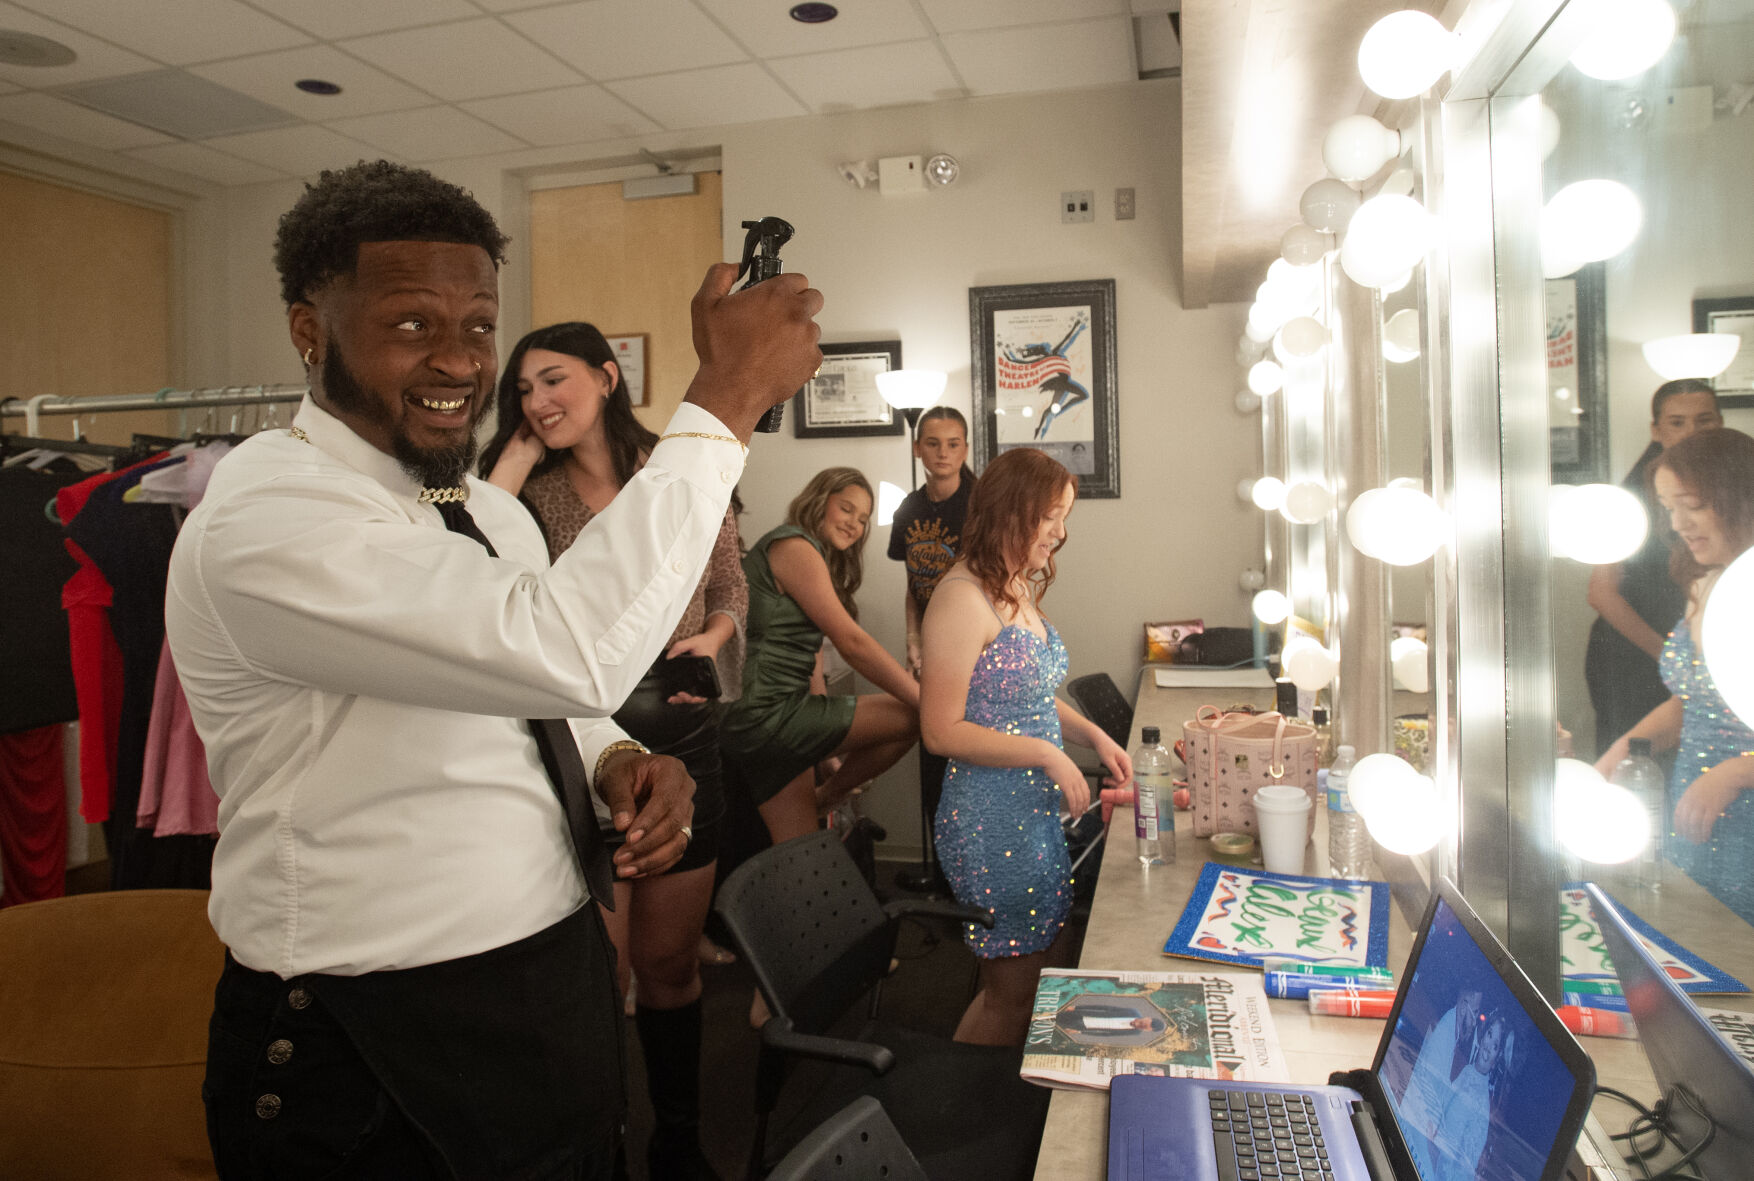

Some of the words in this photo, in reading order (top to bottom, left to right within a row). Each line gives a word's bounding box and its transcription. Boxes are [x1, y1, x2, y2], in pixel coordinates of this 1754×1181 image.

[998, 356, 1030, 370] DANCE
[998, 368, 1039, 380] THEATRE
[998, 377, 1039, 389] HARLEM
[1231, 884, 1298, 949] Alex
[1201, 976, 1246, 1061] Meridional
[1245, 997, 1262, 1034] WEEKEND
